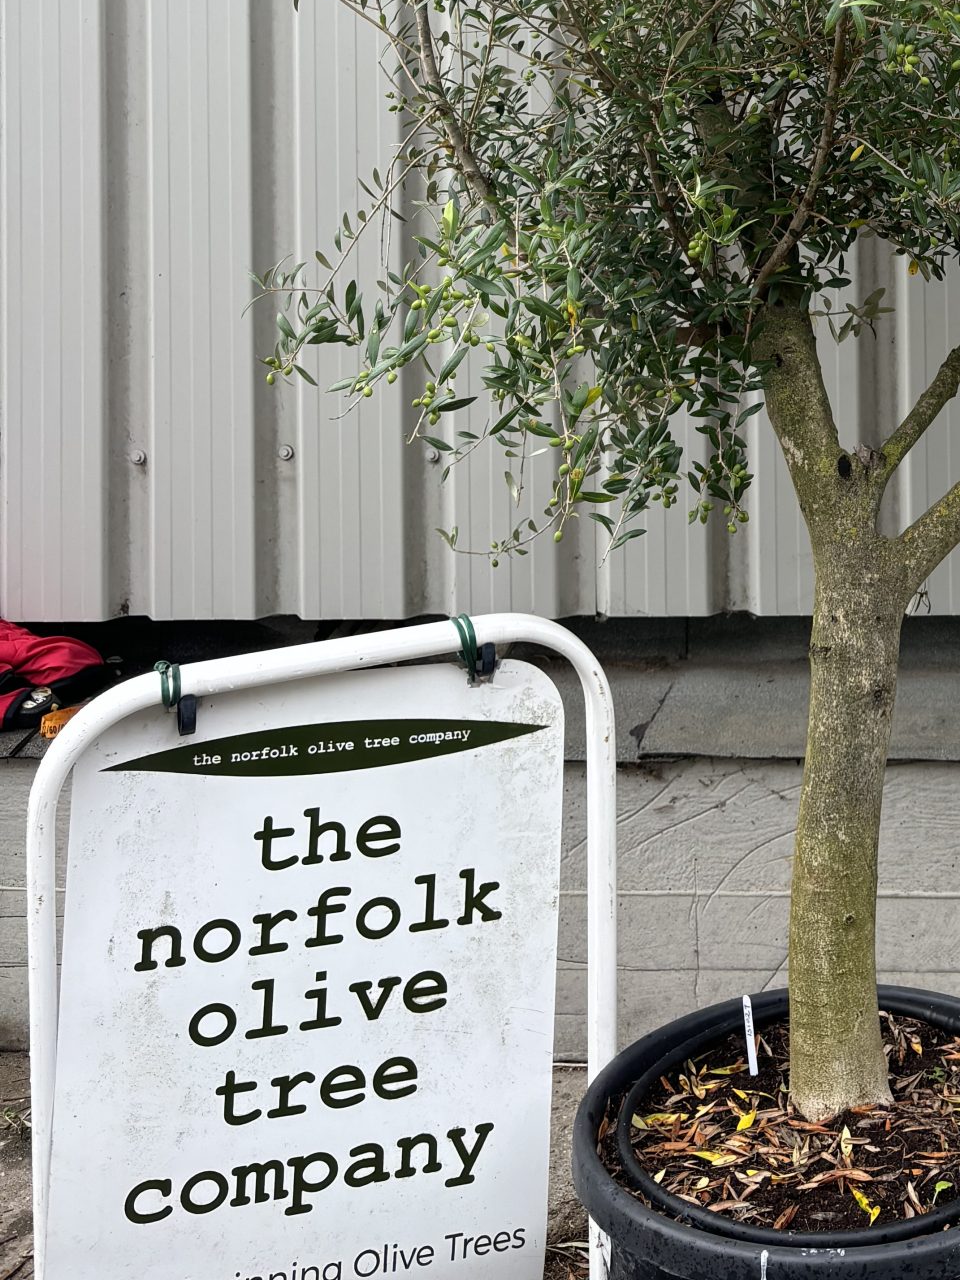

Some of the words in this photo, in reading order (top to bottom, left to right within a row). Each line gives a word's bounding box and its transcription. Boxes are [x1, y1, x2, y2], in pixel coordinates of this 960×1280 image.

[193, 753, 222, 767] the
[230, 744, 299, 763] norfolk
[307, 740, 355, 755] olive
[364, 736, 401, 750] tree
[408, 728, 472, 745] company
[253, 807, 402, 871] the
[133, 868, 503, 972] norfolk
[188, 970, 448, 1047] olive
[215, 1056, 419, 1126] tree
[124, 1122, 495, 1225] company
[235, 1261, 342, 1280] ing
[353, 1243, 435, 1278] Olive
[444, 1227, 526, 1262] Trees
